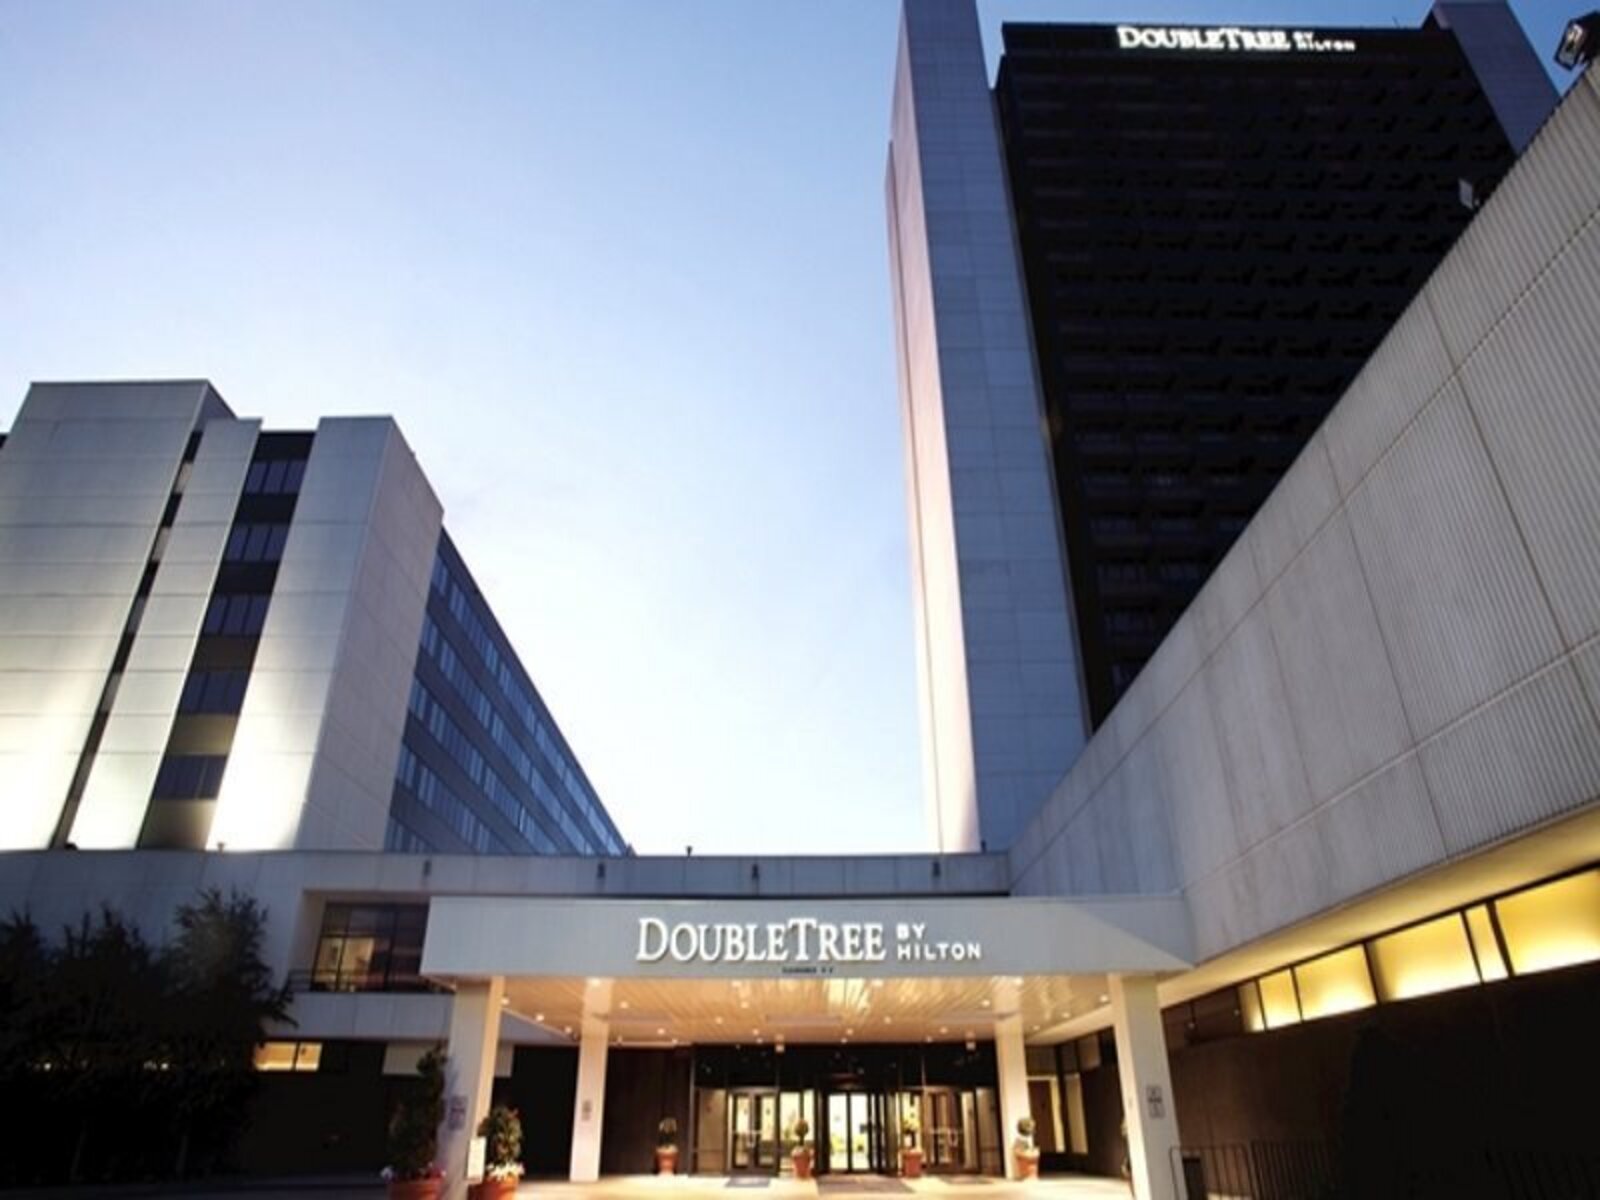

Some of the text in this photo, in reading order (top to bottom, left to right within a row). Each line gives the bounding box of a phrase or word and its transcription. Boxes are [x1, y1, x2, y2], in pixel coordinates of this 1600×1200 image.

[636, 916, 886, 962] DOUBLETREE
[896, 923, 926, 940] BY
[897, 942, 981, 961] HILTON
